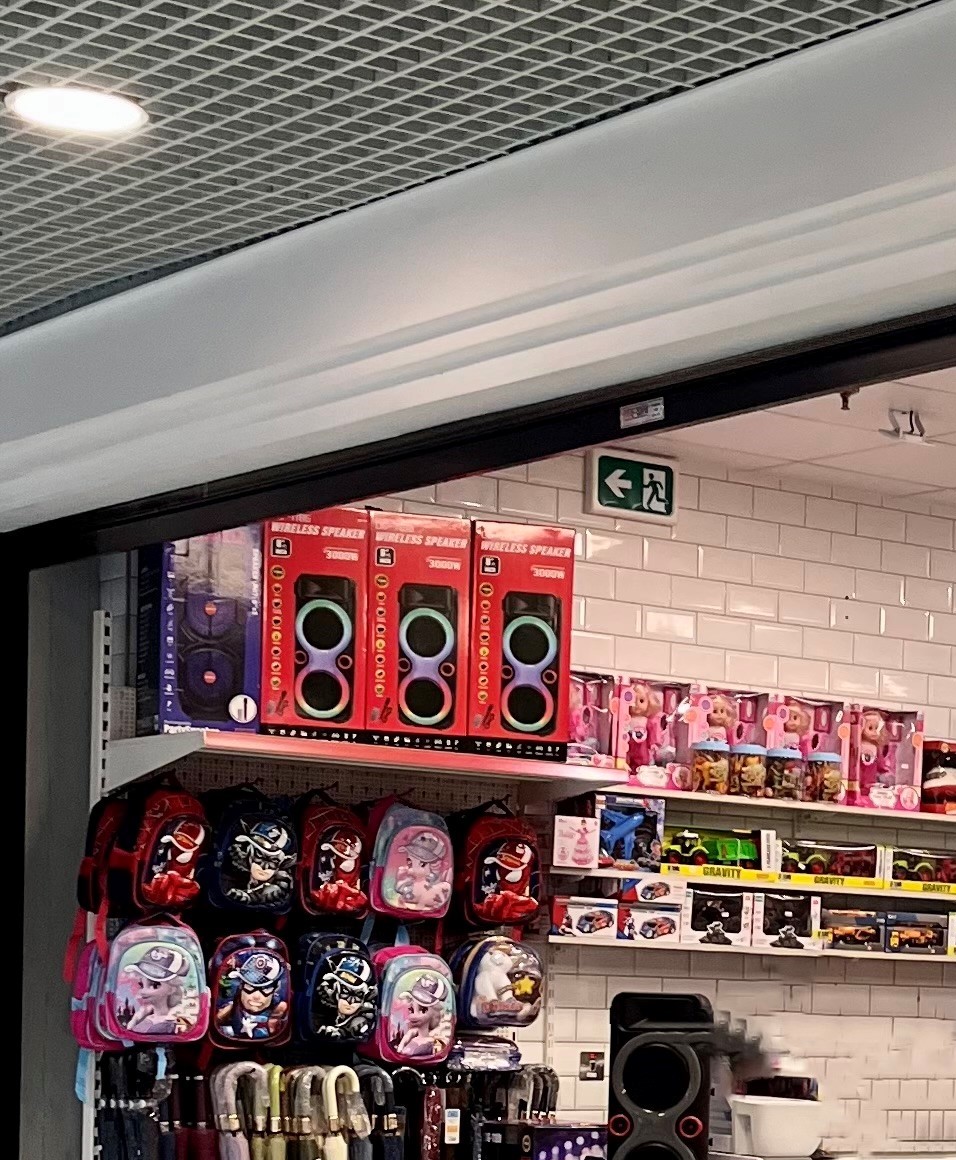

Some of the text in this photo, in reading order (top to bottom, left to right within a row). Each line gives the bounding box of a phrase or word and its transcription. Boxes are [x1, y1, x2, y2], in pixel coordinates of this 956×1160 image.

[271, 521, 366, 540] WIRELESS SPEAKER
[375, 531, 468, 549] WIRELESS SPEAKER
[480, 540, 572, 558] WIRELESS SPEAKER
[702, 866, 742, 879] GRAVITY
[814, 875, 845, 886] GRAVITY
[922, 883, 951, 893] GRAVITY
